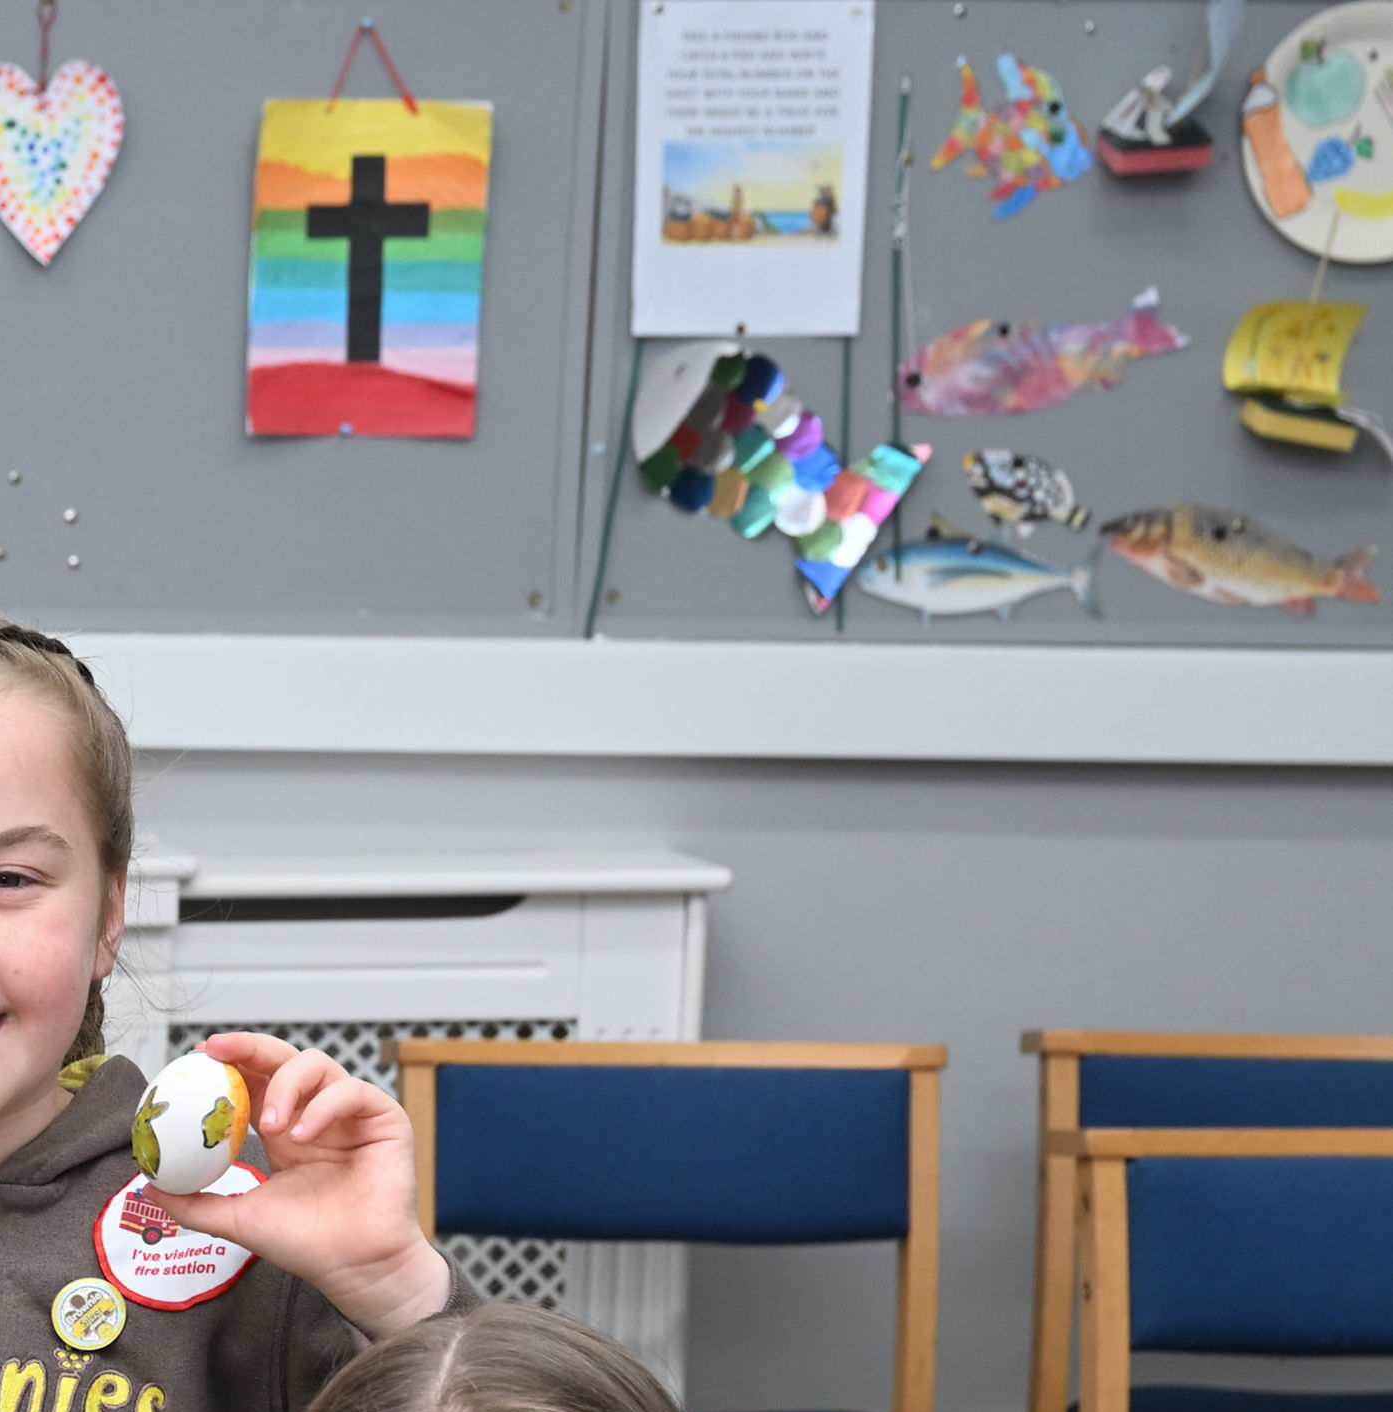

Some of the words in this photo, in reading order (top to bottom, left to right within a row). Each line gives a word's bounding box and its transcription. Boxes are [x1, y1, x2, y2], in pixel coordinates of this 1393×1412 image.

[165, 1243, 213, 1261] visited
[215, 1245, 227, 1256] a
[134, 1265, 160, 1276] fire
[162, 1261, 216, 1276] station
[65, 1291, 104, 1324] Brownie
[79, 1306, 103, 1328] Silver
